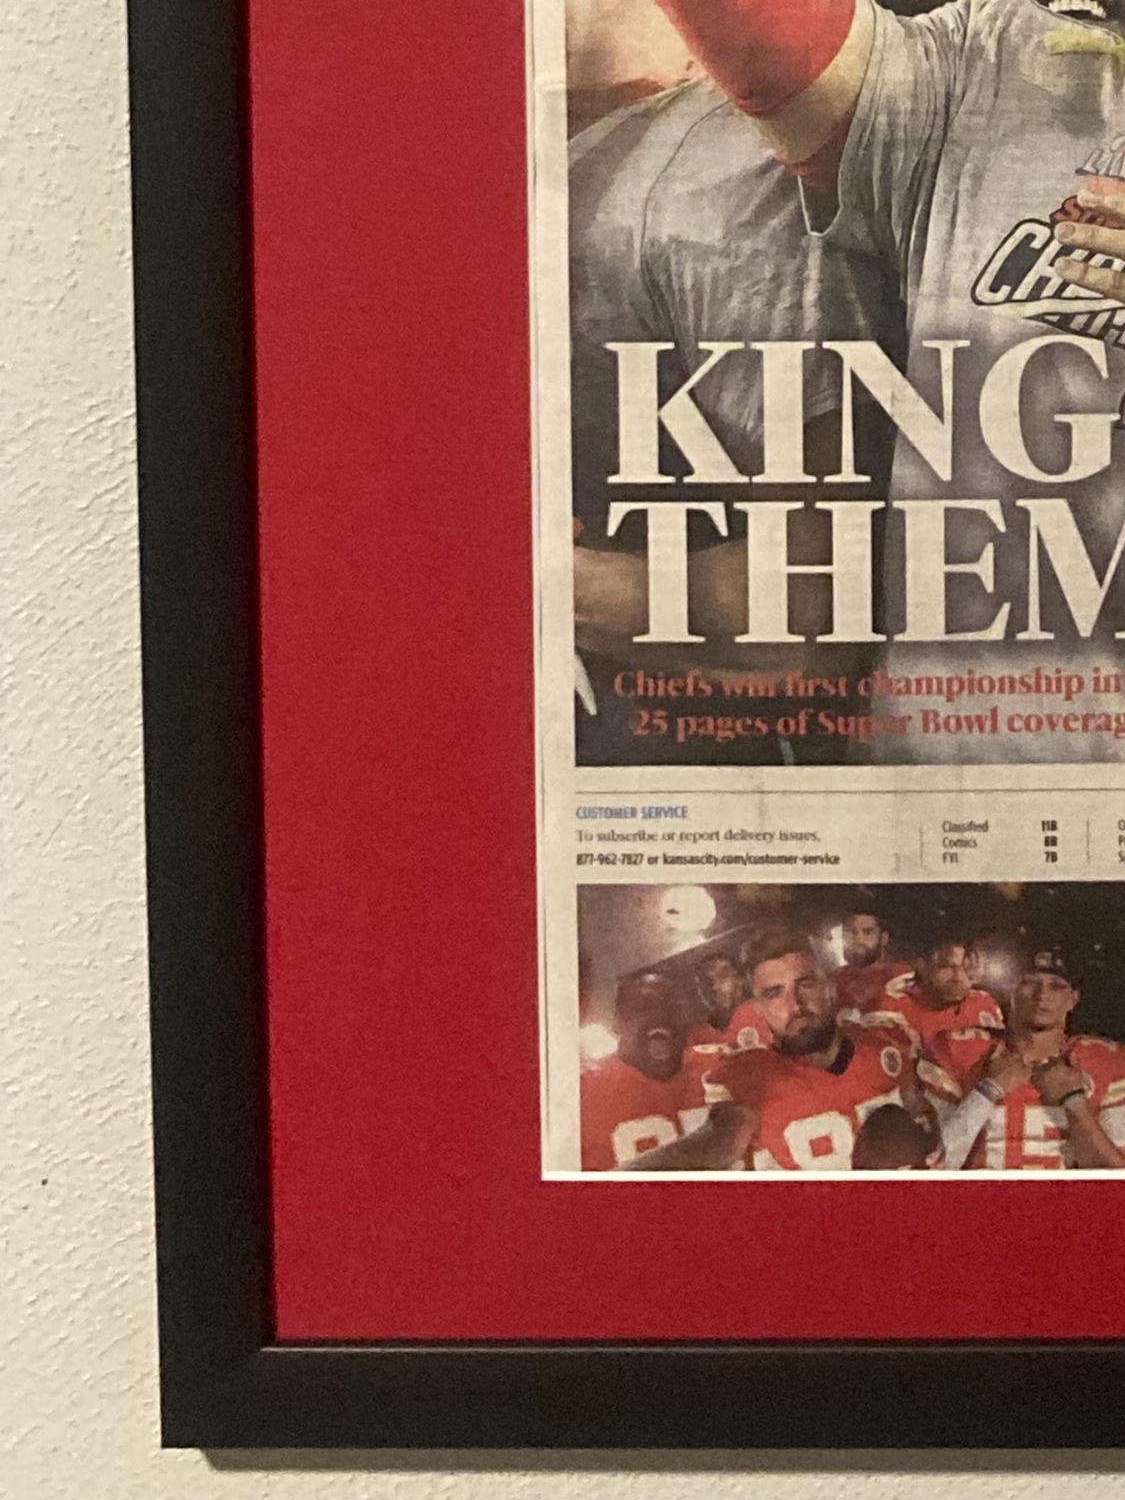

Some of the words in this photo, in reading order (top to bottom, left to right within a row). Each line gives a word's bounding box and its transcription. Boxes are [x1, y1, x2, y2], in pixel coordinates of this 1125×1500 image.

[605, 335, 1121, 484] KING
[614, 668, 713, 698] Chiefs
[720, 670, 778, 698] win
[784, 667, 849, 698] first
[857, 666, 1085, 703] championship
[1091, 666, 1122, 694] in
[633, 708, 669, 736] 25
[676, 712, 769, 743] pages
[776, 707, 813, 736] of
[818, 708, 913, 742] Super
[920, 705, 999, 735] Bowl
[576, 806, 637, 819] CUSTOMER
[641, 806, 689, 819] SERVICE
[942, 820, 989, 833] Classified
[576, 829, 594, 842] To
[596, 829, 659, 842] subscribe
[661, 831, 675, 842] or
[679, 830, 721, 846] report
[724, 829, 775, 846] delivery
[942, 837, 977, 849] Comics
[647, 855, 660, 866] or
[663, 853, 841, 867] kansascity.com/customer-service
